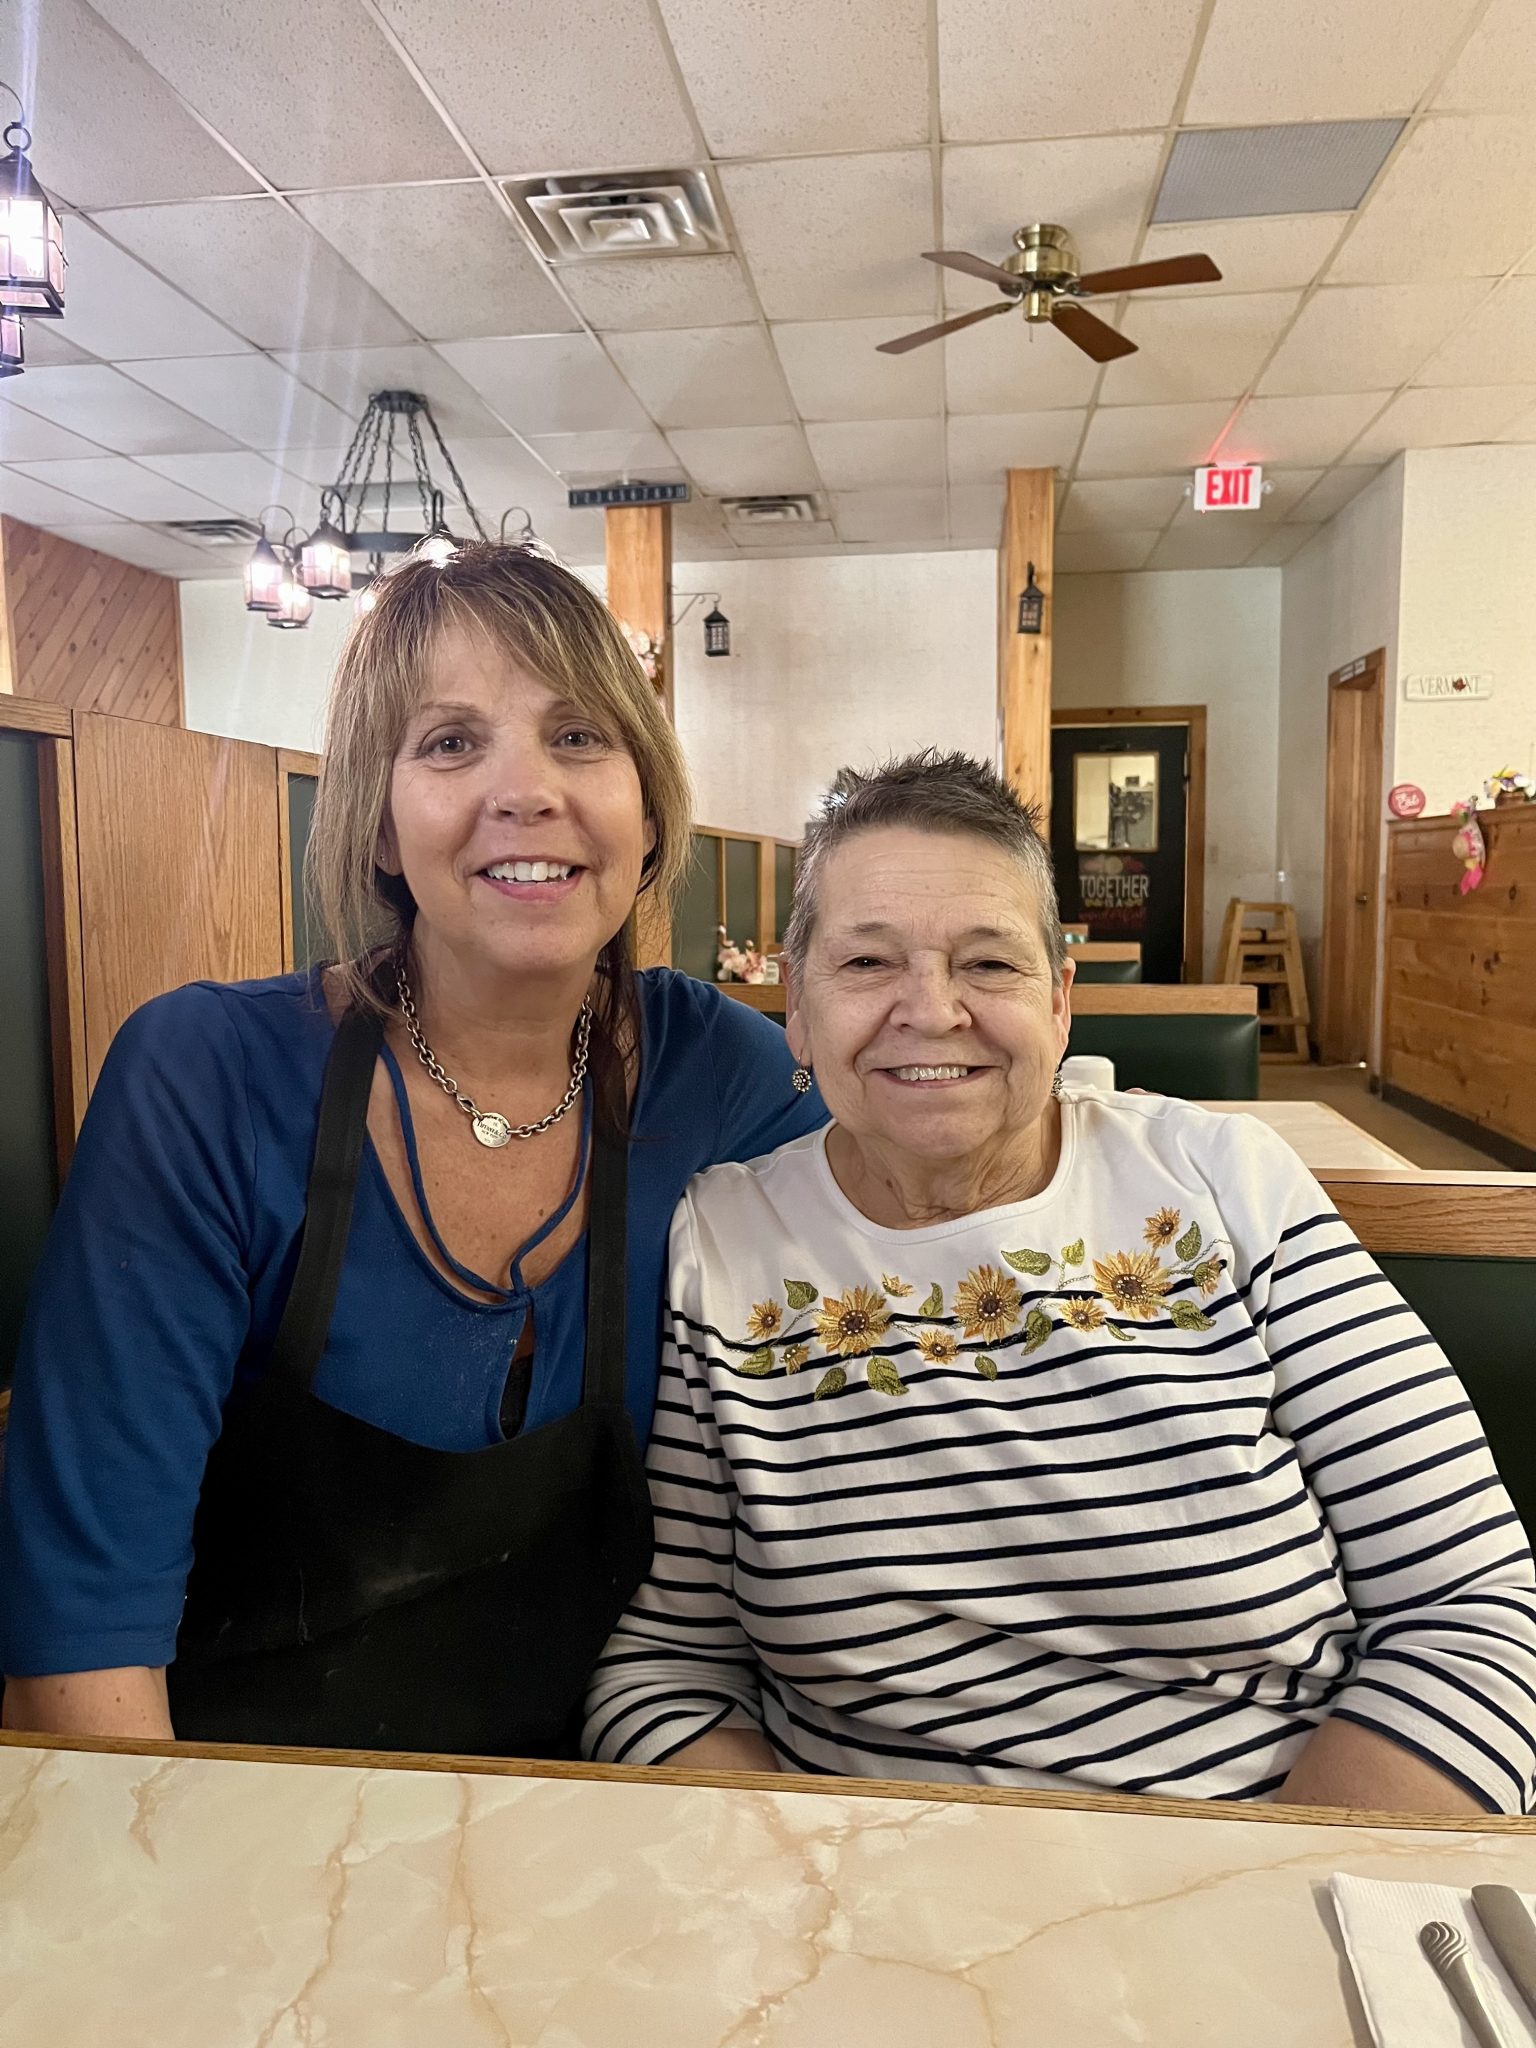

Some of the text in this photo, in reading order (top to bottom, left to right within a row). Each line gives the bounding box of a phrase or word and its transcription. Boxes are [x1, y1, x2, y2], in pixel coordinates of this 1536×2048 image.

[1206, 468, 1253, 505] EXIT
[1419, 674, 1481, 696] VERMNT
[1080, 874, 1149, 898] TOGETHER
[1115, 898, 1123, 908] A
